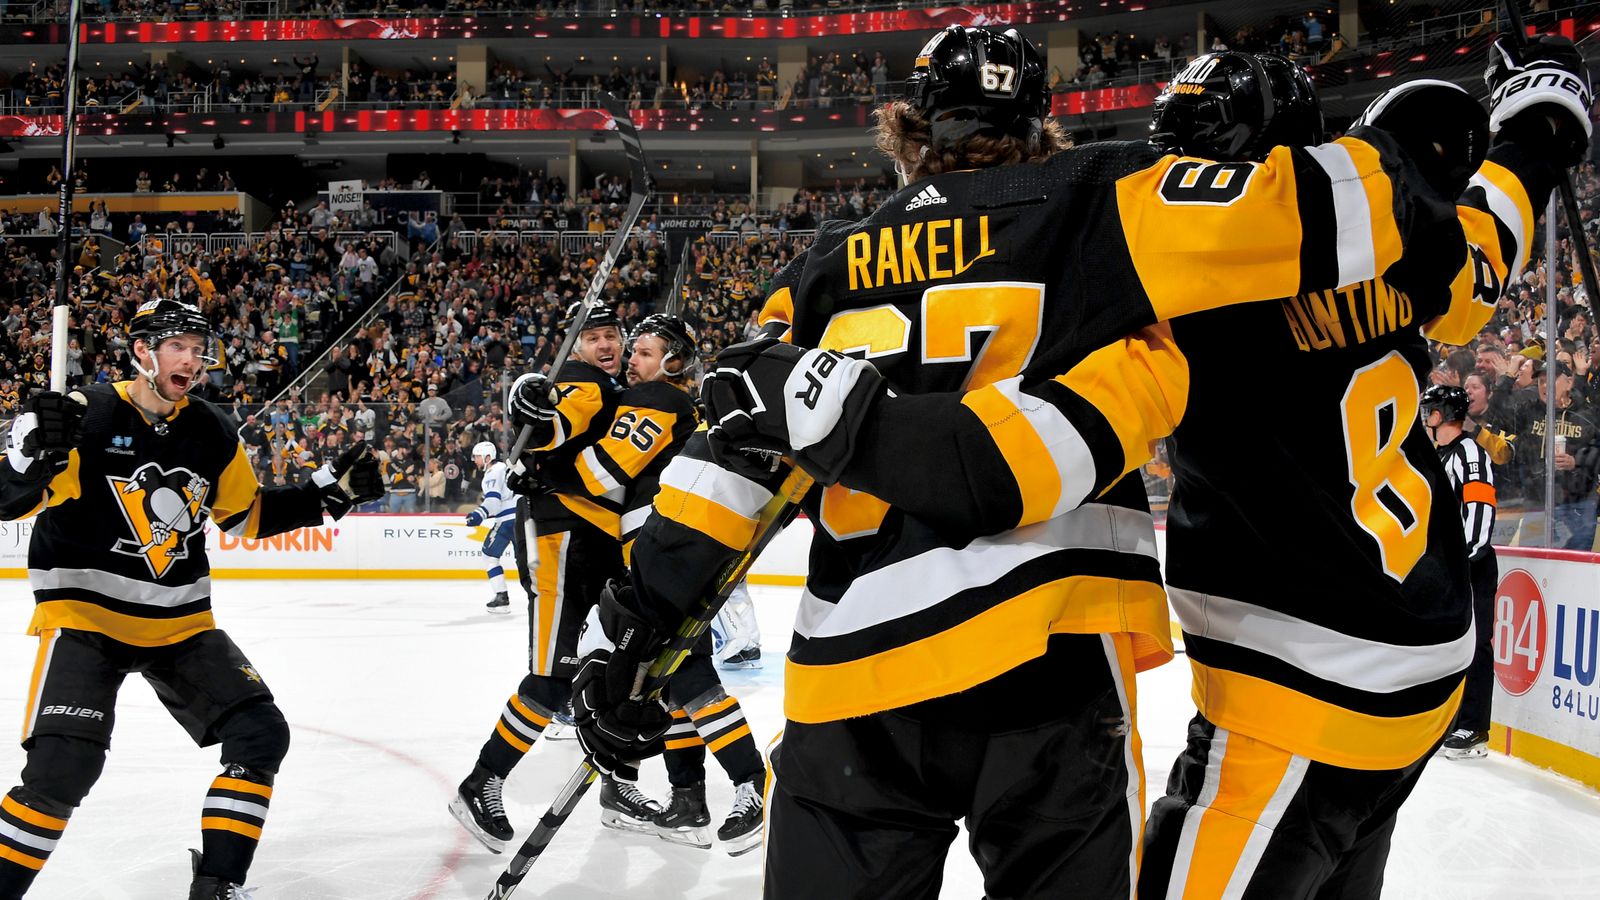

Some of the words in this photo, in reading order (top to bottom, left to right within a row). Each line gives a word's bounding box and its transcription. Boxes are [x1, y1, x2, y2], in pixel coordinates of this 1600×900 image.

[981, 63, 1015, 92] 67
[905, 197, 947, 211] adidas
[689, 219, 701, 228] OF
[847, 215, 995, 290] RAKELL
[584, 250, 614, 308] CCM
[610, 412, 664, 453] 65
[1531, 420, 1582, 438] PEUINS
[1340, 350, 1432, 584] 8
[1469, 462, 1479, 473] 18
[384, 529, 454, 539] RIVERS
[618, 628, 634, 651] RAKELL
[1494, 596, 1539, 673] 84
[41, 705, 104, 721] BAUER
